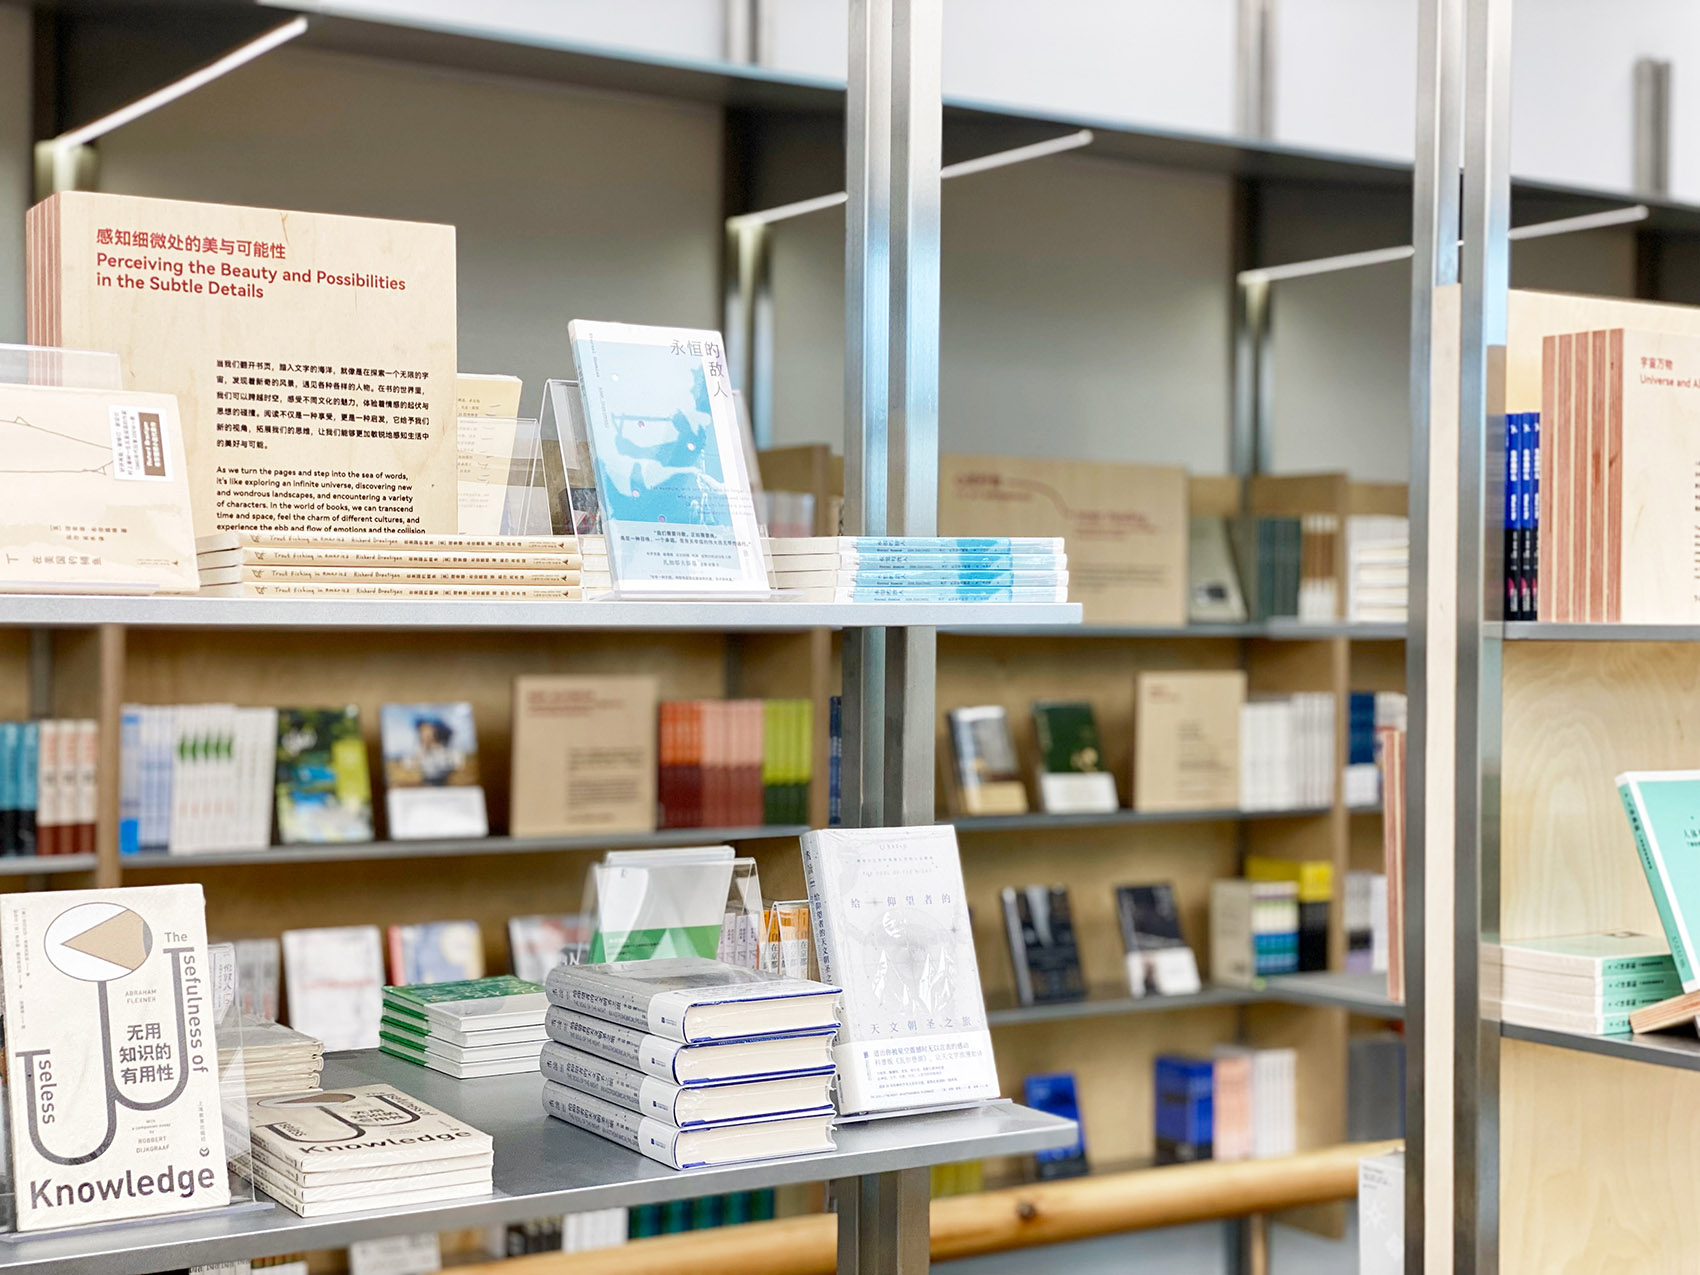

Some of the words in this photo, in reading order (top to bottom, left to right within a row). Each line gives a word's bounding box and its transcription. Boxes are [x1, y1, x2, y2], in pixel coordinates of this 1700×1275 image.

[96, 228, 287, 260] 感知细微处的美与可能性
[97, 253, 183, 277] Perceiving
[188, 260, 215, 275] the
[221, 262, 277, 283] Beauty
[282, 268, 311, 283] and
[317, 270, 406, 290] Possibilities
[97, 274, 111, 287] in
[116, 275, 145, 289] the
[149, 277, 203, 294] Subtle
[208, 281, 263, 299] Details
[259, 467, 272, 475] the
[273, 469, 296, 477] pages
[313, 470, 330, 478] step
[331, 470, 346, 478] into
[347, 470, 360, 478] the
[375, 471, 383, 479] of
[384, 472, 408, 481] words,
[229, 477, 243, 485] like
[244, 478, 280, 488] exploring
[293, 480, 319, 488] infinite
[320, 481, 353, 490] universe,
[354, 482, 396, 492] discovering
[232, 489, 270, 497] wondrous
[272, 490, 315, 500] landscapes,
[332, 493, 380, 502] encountering
[388, 494, 413, 503] variety
[226, 500, 268, 508] characters.
[279, 501, 292, 509] the
[293, 502, 315, 510] world
[316, 502, 324, 510] of
[326, 503, 350, 512] books,
[378, 505, 413, 513] transcend
[216, 511, 234, 519] time
[252, 513, 275, 521] space,
[277, 512, 291, 520] feel
[292, 513, 305, 521] the
[331, 514, 340, 522] of
[341, 514, 372, 523] different
[374, 515, 405, 524] cultures,
[406, 516, 420, 524] and
[216, 523, 258, 531] experience
[306, 524, 322, 532] flow
[164, 931, 188, 943] The
[125, 988, 157, 998] ABRAHAM
[126, 1022, 162, 1042] 无用
[119, 1042, 172, 1064] 知识的
[192, 1055, 208, 1073] of
[120, 1064, 175, 1085] 有用性
[299, 1130, 473, 1155] Knowledge
[29, 1164, 216, 1210] Knowledge
